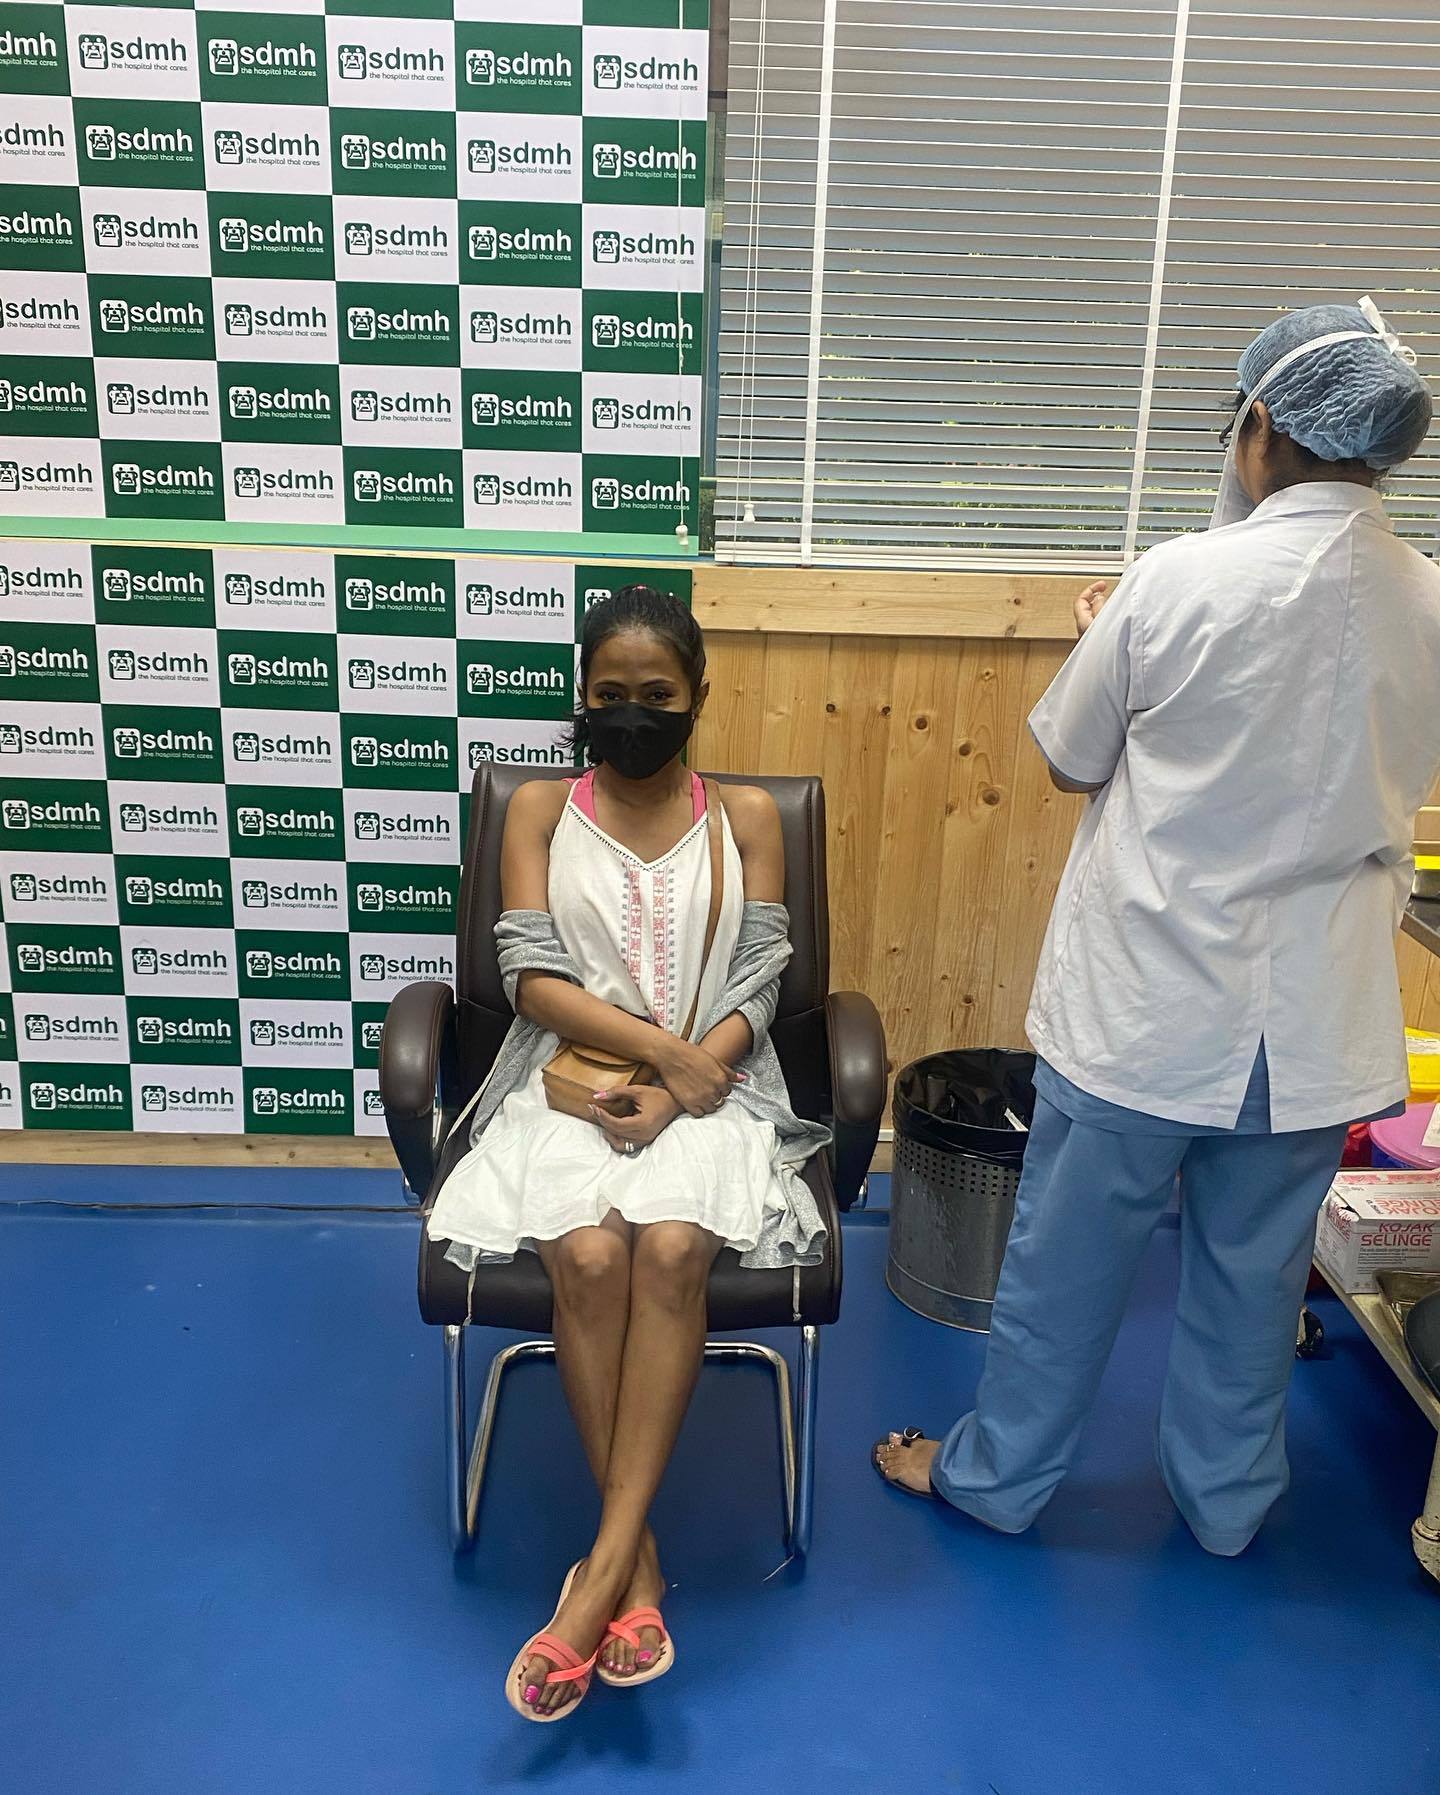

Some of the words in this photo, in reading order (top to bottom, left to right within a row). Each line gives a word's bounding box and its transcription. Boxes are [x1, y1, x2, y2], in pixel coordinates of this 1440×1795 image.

[0, 31, 56, 56] dmh
[111, 37, 186, 61] sdmh
[240, 41, 316, 67] sdmh
[369, 47, 443, 71] sdmh
[497, 52, 571, 76] sdmh
[625, 57, 697, 81] sdmh
[254, 68, 283, 76] hospital
[510, 78, 537, 86] hospital
[0, 123, 64, 146] dmh
[117, 127, 192, 152] sdmh
[246, 133, 319, 156] sdmh
[372, 137, 445, 161] sdmh
[499, 142, 571, 165] sdmh
[623, 146, 696, 169] sdmh
[0, 212, 72, 235] sdmh
[125, 217, 197, 239] sdmh
[250, 220, 323, 243] sdmh
[375, 225, 447, 247] sdmh
[499, 228, 571, 251] sdmh
[623, 233, 694, 255] sdmh
[6, 298, 78, 320] sdmh
[131, 302, 203, 324] sdmh
[255, 306, 326, 327] sdmh
[378, 309, 449, 332] sdmh
[501, 313, 571, 335] sdmh
[622, 317, 692, 339] sdmh
[14, 381, 86, 403] sdmh
[137, 385, 208, 406] sdmh
[259, 388, 330, 410] sdmh
[381, 392, 450, 413] sdmh
[501, 395, 571, 417] sdmh
[622, 400, 690, 421] sdmh
[22, 463, 92, 483] sdmh
[142, 465, 213, 487] sdmh
[264, 469, 333, 490] sdmh
[383, 472, 453, 494] sdmh
[503, 477, 571, 497] sdmh
[621, 481, 689, 501] sdmh
[12, 567, 82, 588] sdmh
[133, 571, 204, 593] sdmh
[255, 576, 324, 597] sdmh
[375, 581, 445, 603] sdmh
[495, 587, 564, 608] sdmh
[17, 647, 88, 669] sdmh
[138, 652, 207, 673] sdmh
[258, 656, 328, 678] sdmh
[378, 662, 446, 682] sdmh
[496, 666, 564, 688] sdmh
[24, 726, 93, 746] sdmh
[143, 730, 212, 751] sdmh
[262, 735, 330, 755] sdmh
[380, 739, 448, 760] sdmh
[496, 744, 563, 763] sdmh
[31, 802, 100, 822] sdmh
[149, 806, 217, 825] sdmh
[266, 810, 334, 829] sdmh
[383, 814, 449, 833] sdmh
[39, 875, 106, 894] sdmh
[154, 879, 222, 898] sdmh
[271, 883, 337, 901] sdmh
[385, 886, 451, 905] sdmh
[46, 946, 112, 965] sdmh
[160, 950, 226, 968] sdmh
[274, 953, 340, 971] sdmh
[387, 956, 452, 974] sdmh
[52, 1016, 118, 1033] sdmh
[165, 1019, 231, 1037] sdmh
[278, 1022, 342, 1039] sdmh
[57, 1084, 122, 1102] sdmh
[169, 1087, 233, 1104] sdmh
[280, 1089, 344, 1107] sdmh
[1379, 1223, 1435, 1233] KOJAK
[1361, 1234, 1433, 1246] SELINGE
